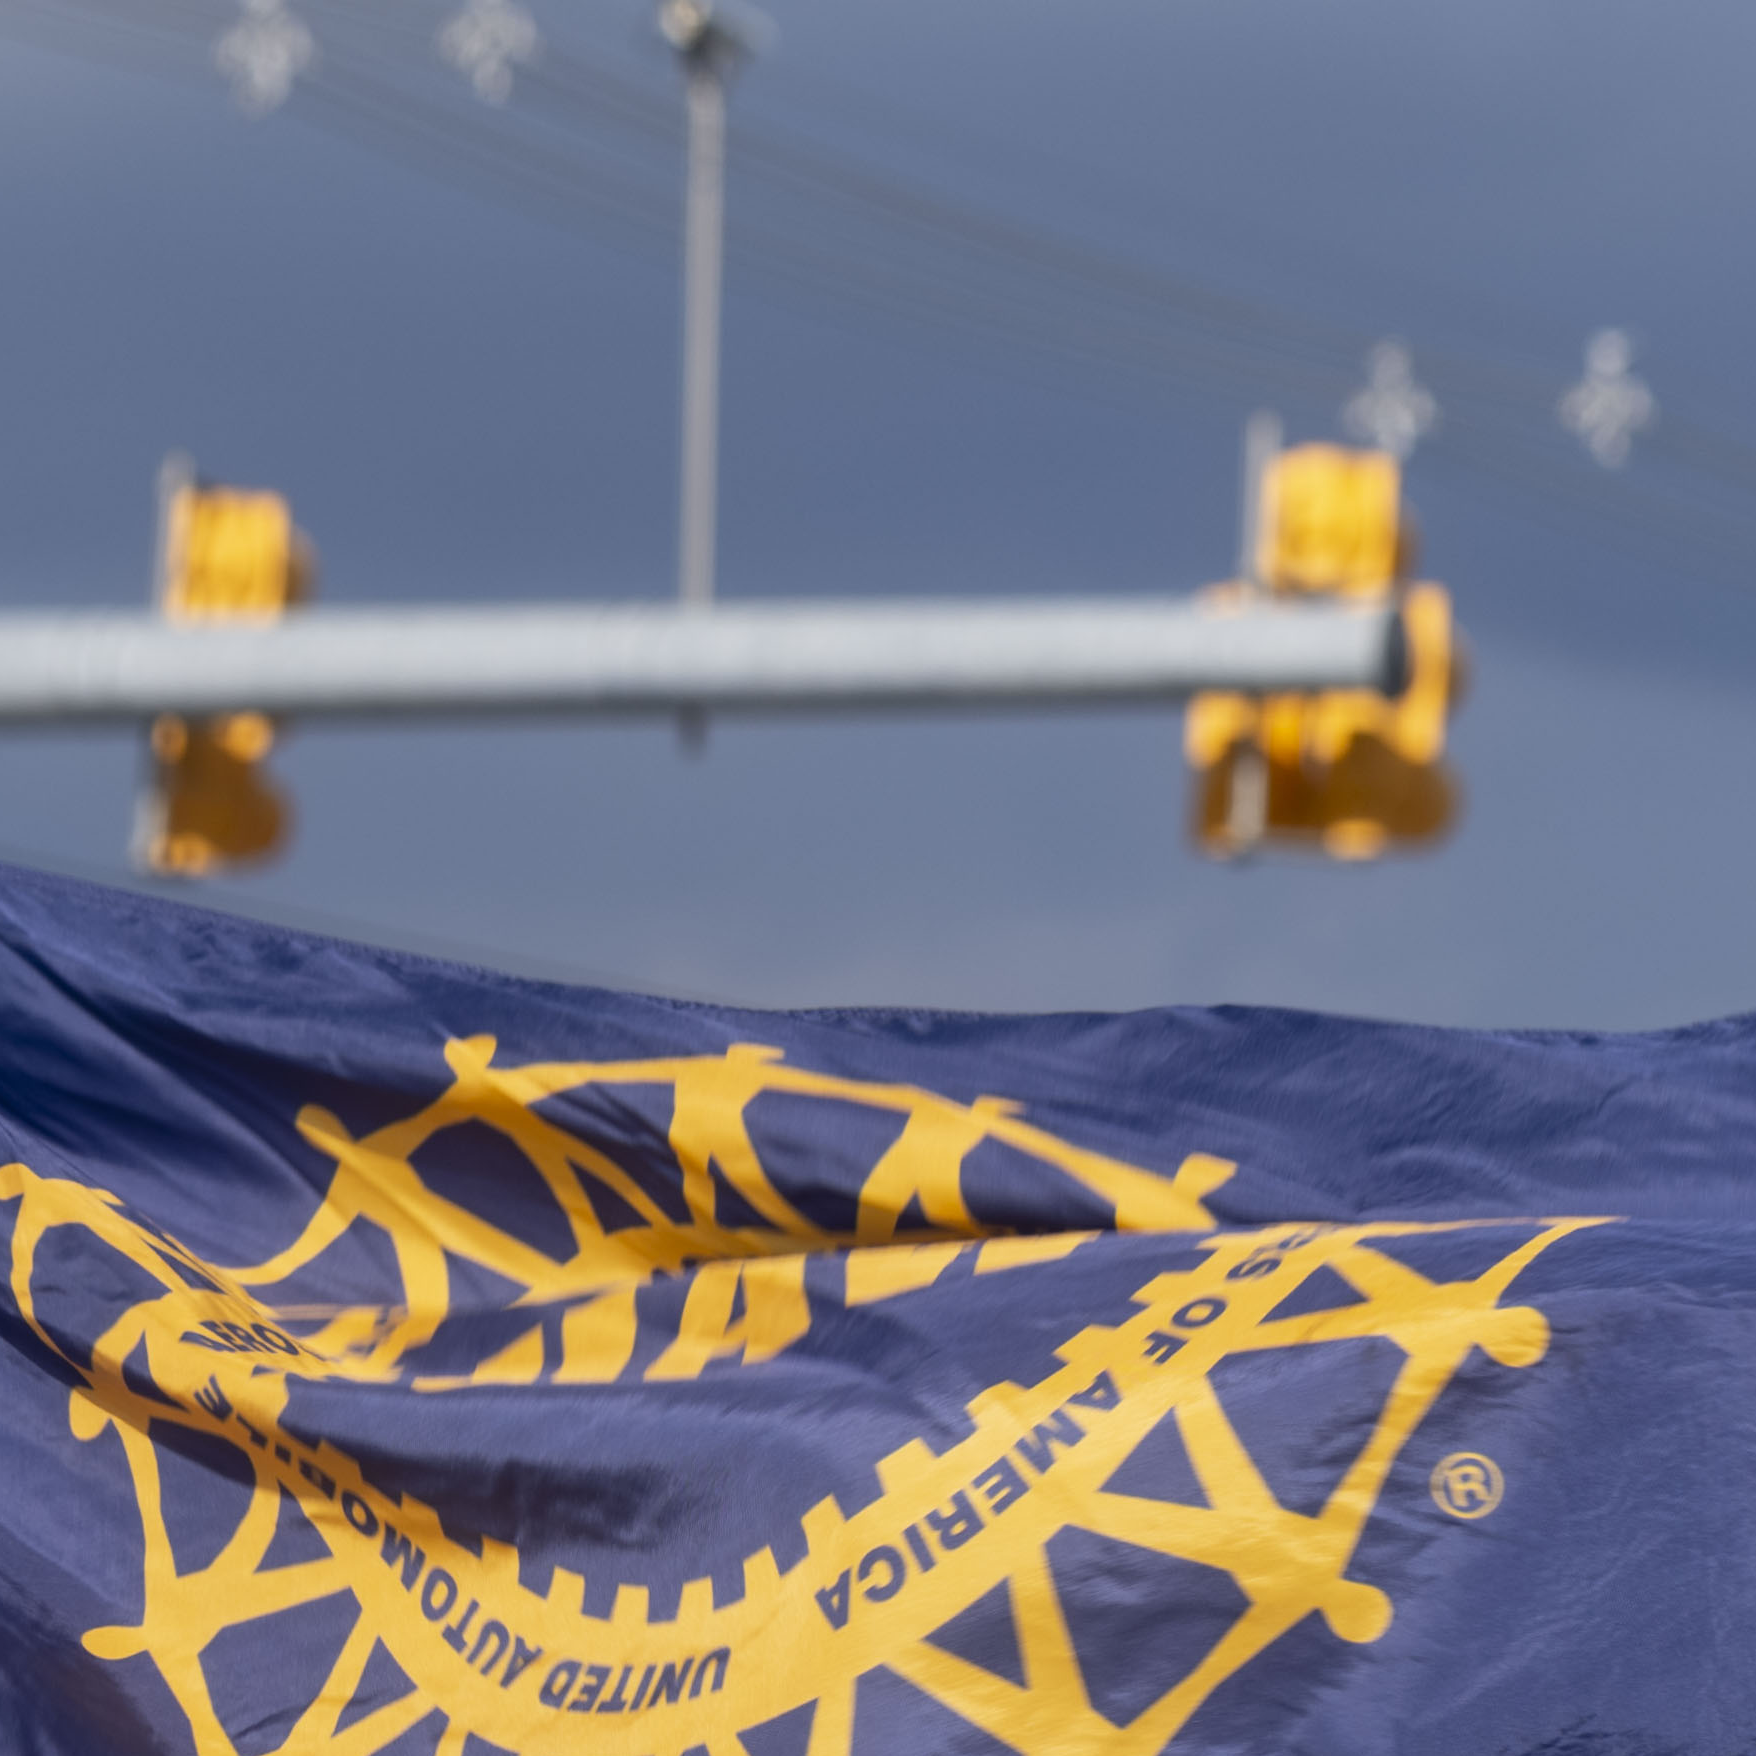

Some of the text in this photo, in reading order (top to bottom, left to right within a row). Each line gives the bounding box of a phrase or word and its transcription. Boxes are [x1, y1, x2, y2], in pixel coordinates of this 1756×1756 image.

[1139, 1296, 1229, 1365] OF
[814, 1369, 1122, 1631] AMERICA
[539, 1646, 731, 1714] UNITED
